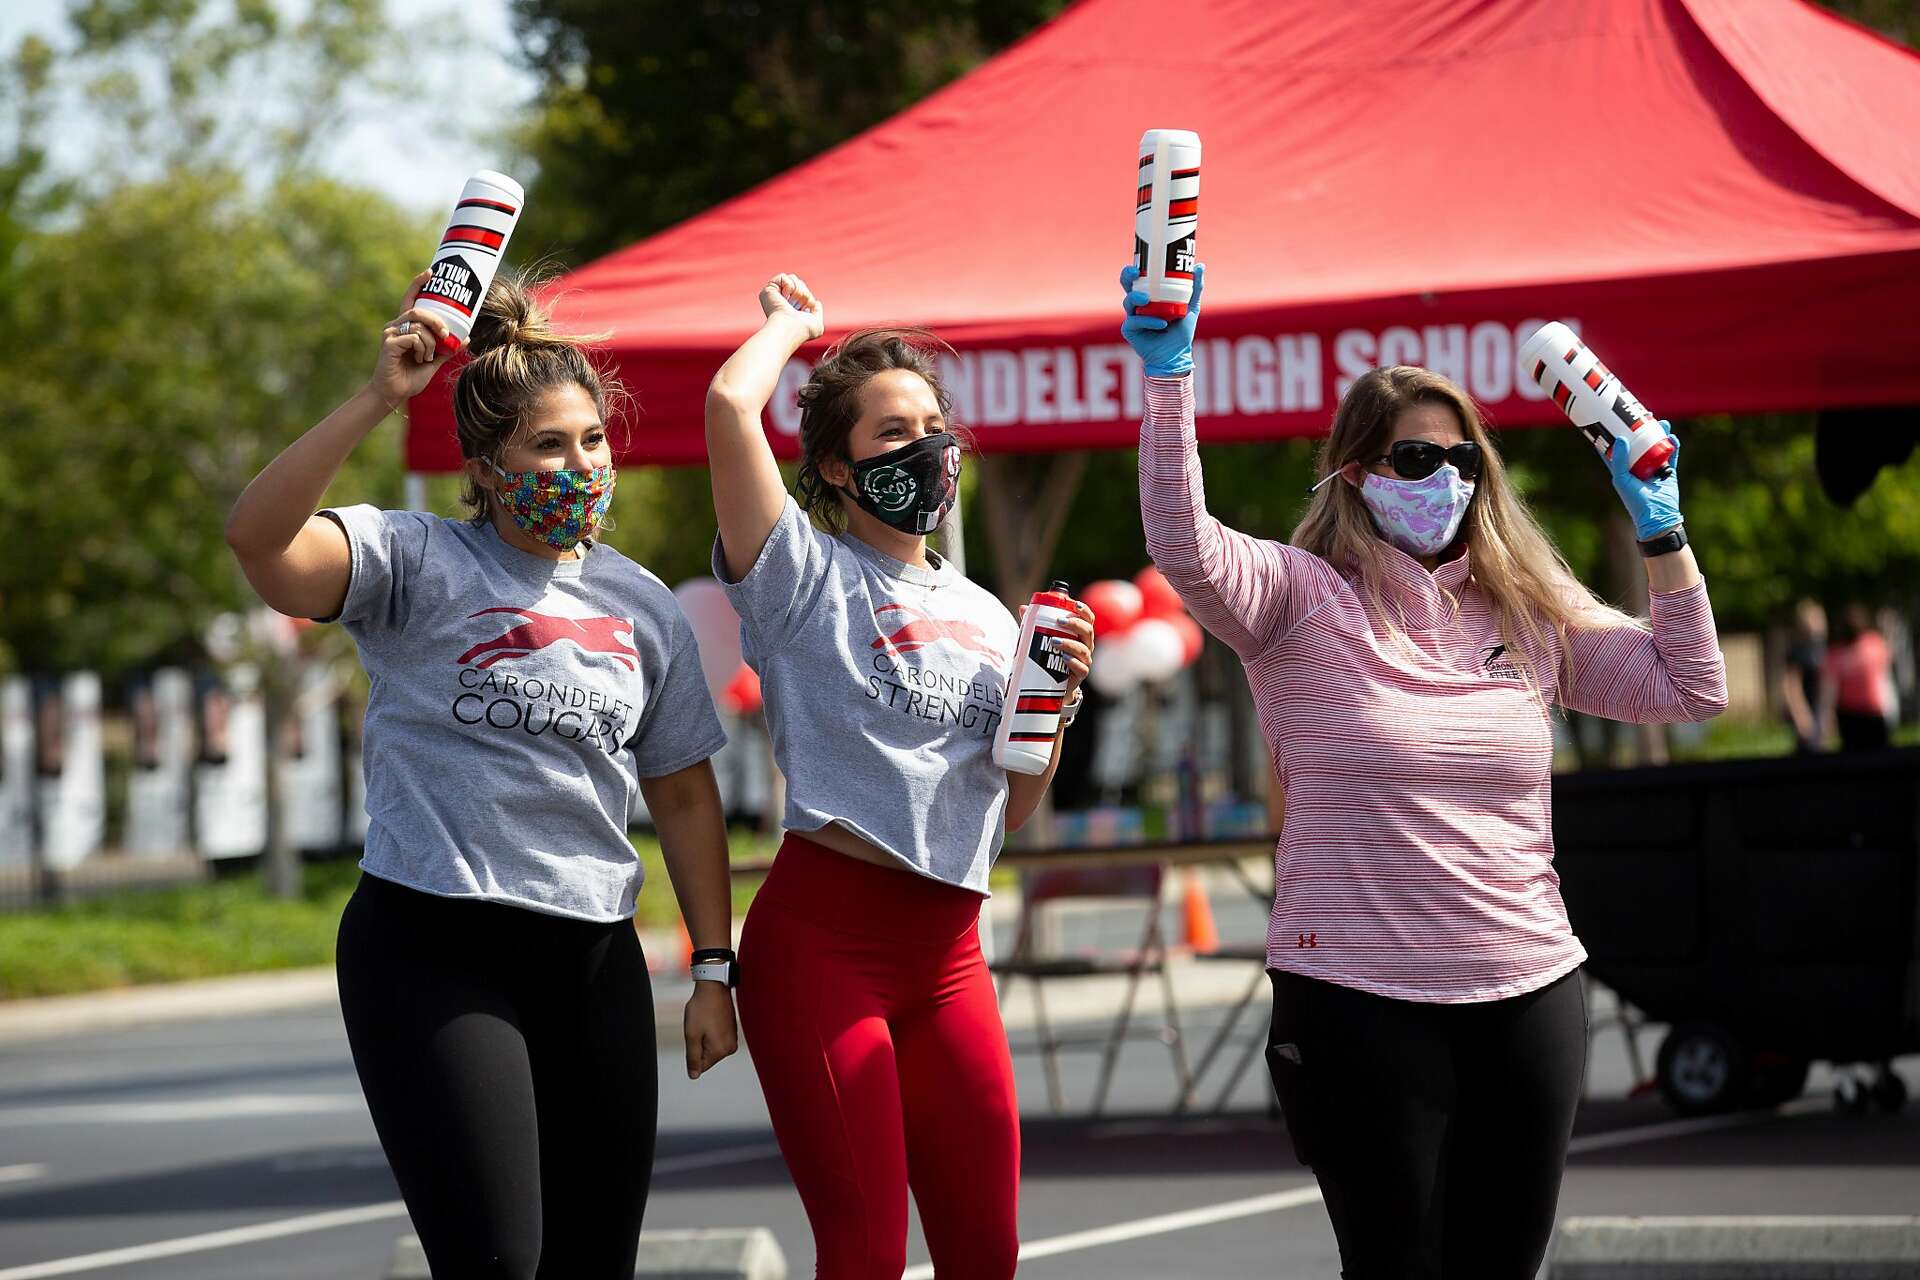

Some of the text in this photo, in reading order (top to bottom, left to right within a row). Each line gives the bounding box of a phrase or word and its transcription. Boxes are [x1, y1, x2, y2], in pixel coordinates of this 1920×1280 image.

[434, 262, 471, 286] MILK
[771, 345, 1144, 437] CNDELET
[1334, 317, 1583, 402] SCHOO
[458, 668, 633, 724] CARONDELET
[865, 676, 1003, 735] STRENGT
[873, 653, 1003, 709] CARONDELE
[452, 692, 624, 756] COUGARS
